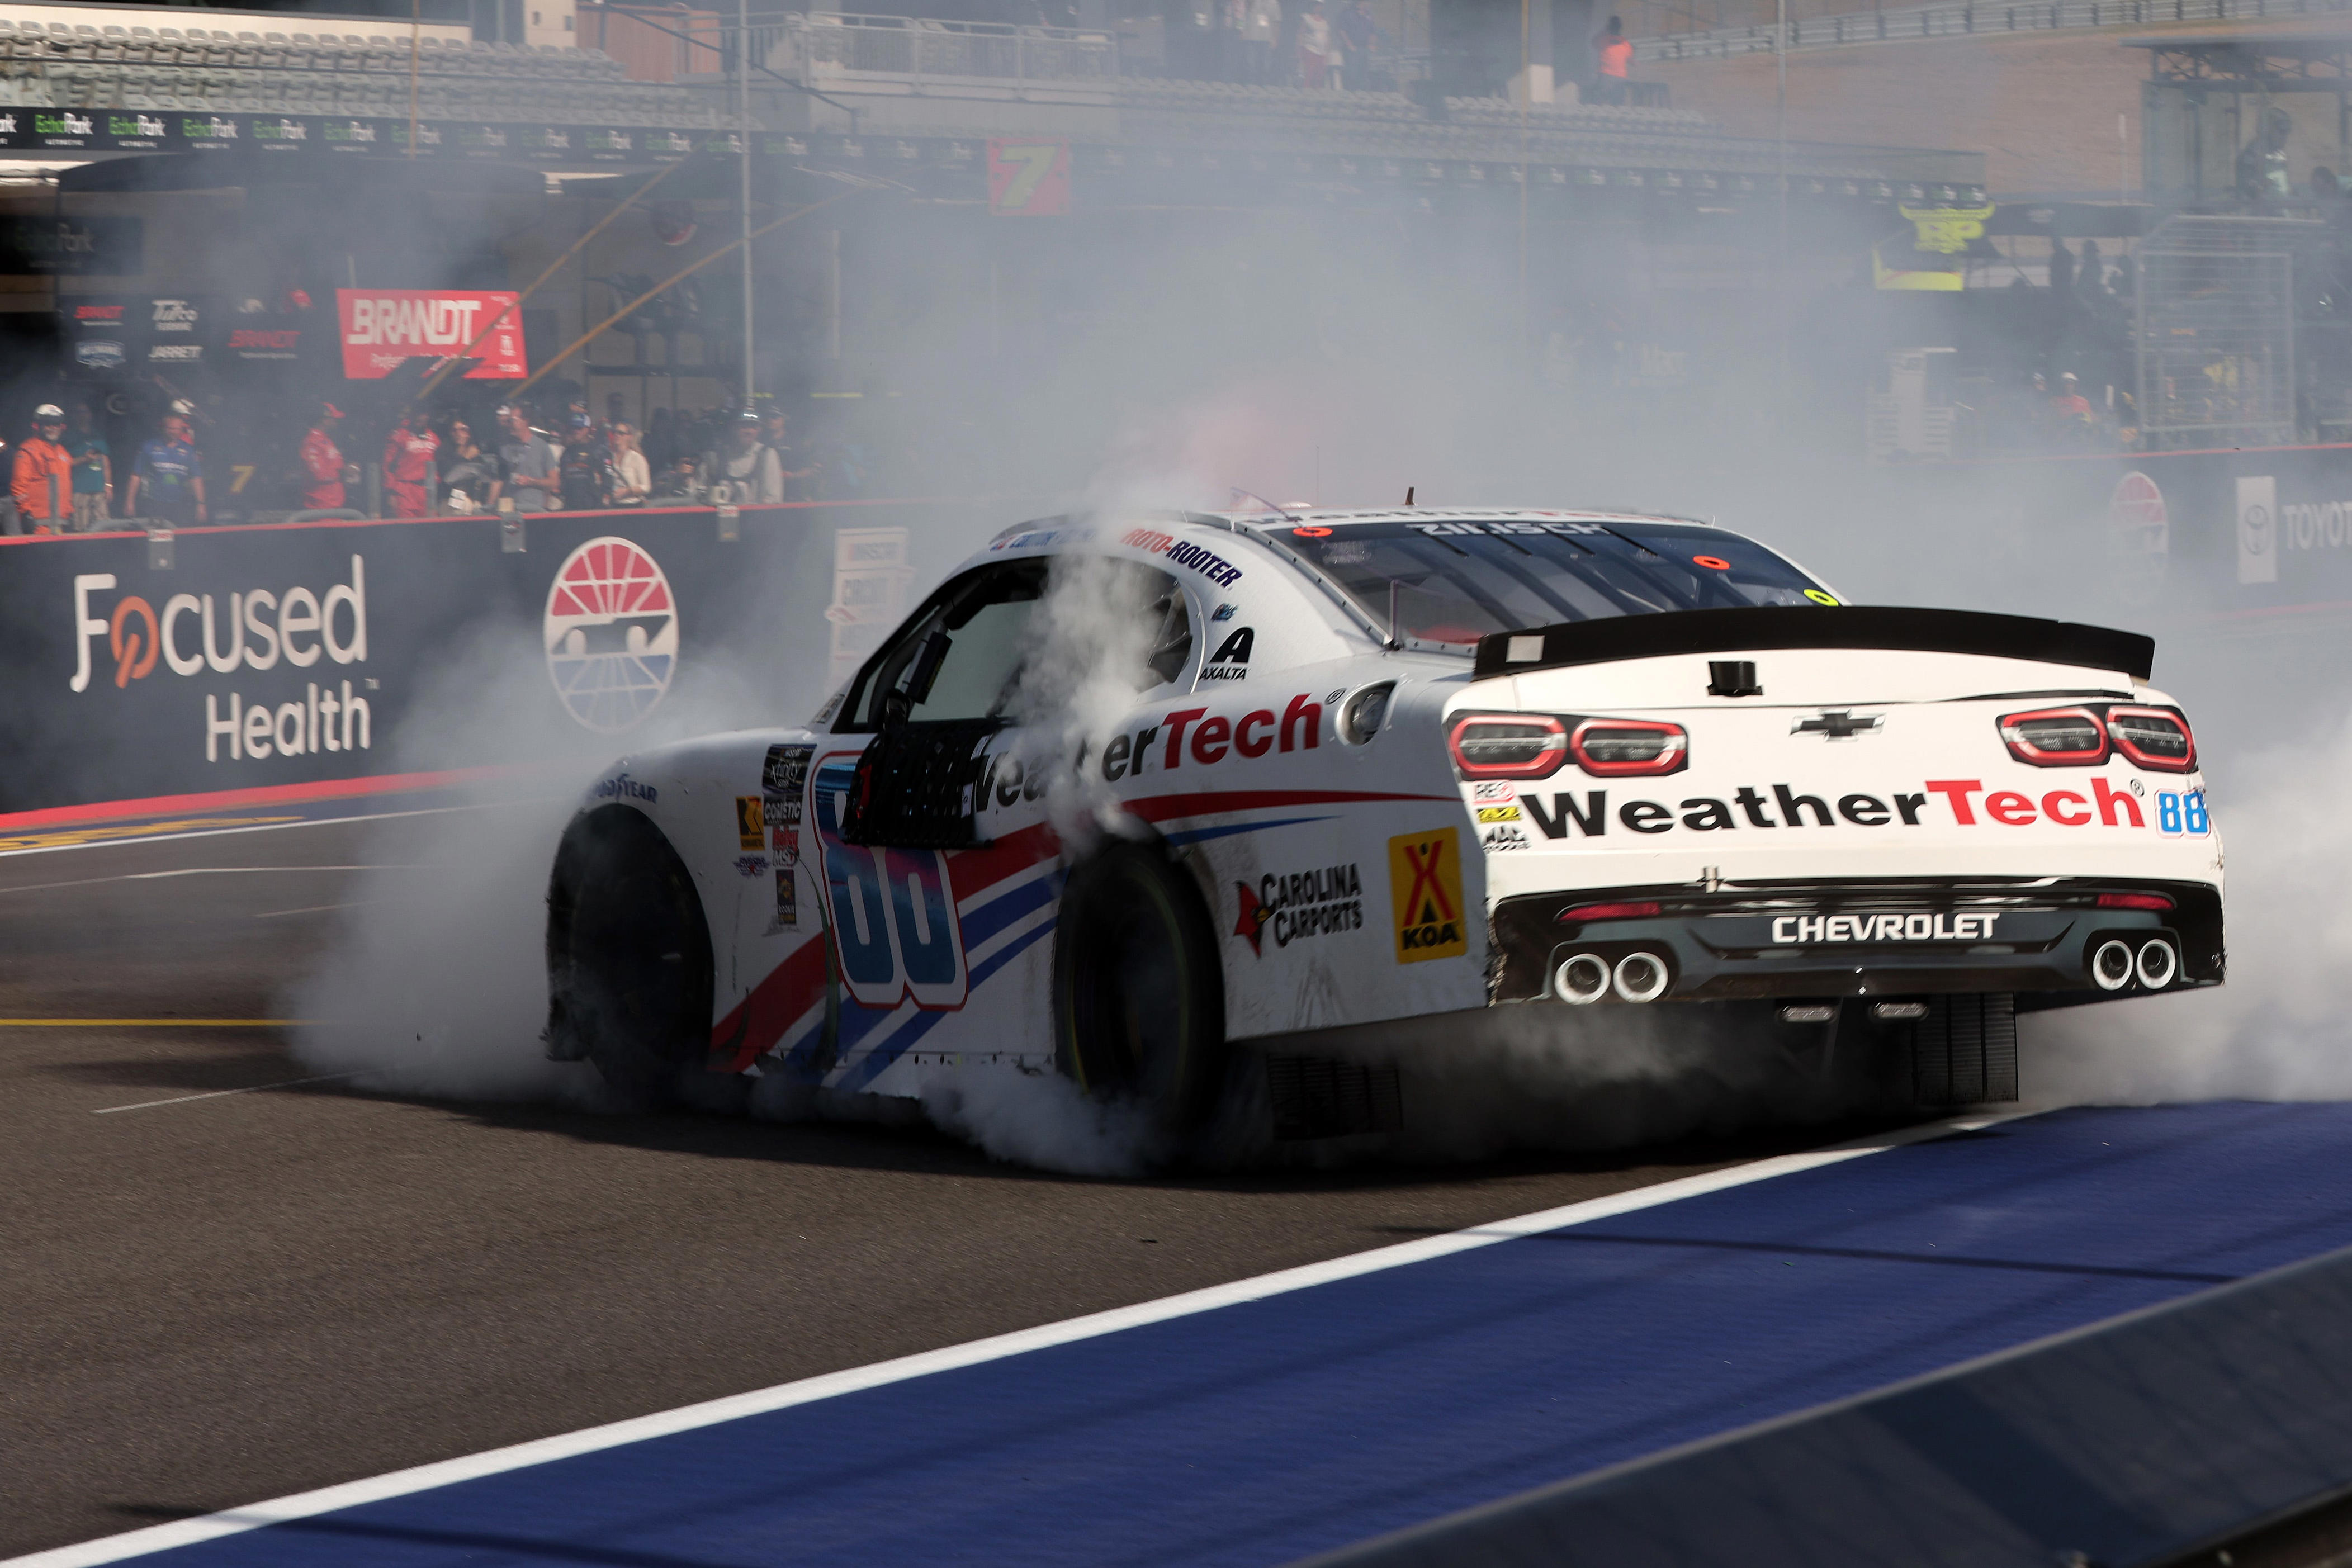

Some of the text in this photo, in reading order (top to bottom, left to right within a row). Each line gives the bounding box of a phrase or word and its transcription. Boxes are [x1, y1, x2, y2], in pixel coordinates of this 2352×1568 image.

[999, 144, 1058, 209] 7
[347, 298, 483, 345] BRANDT
[1120, 527, 1243, 589] ROTO-ROOTER
[69, 553, 368, 693] Focused
[1198, 667, 1248, 681] AXALTA
[205, 679, 371, 763] Health
[2156, 788, 2209, 836] 88
[1260, 863, 1362, 910] CAROLINA
[1274, 900, 1363, 949] CARPORTS
[1401, 919, 1461, 950] KOA
[1772, 912, 2000, 944] CHEVROLET
